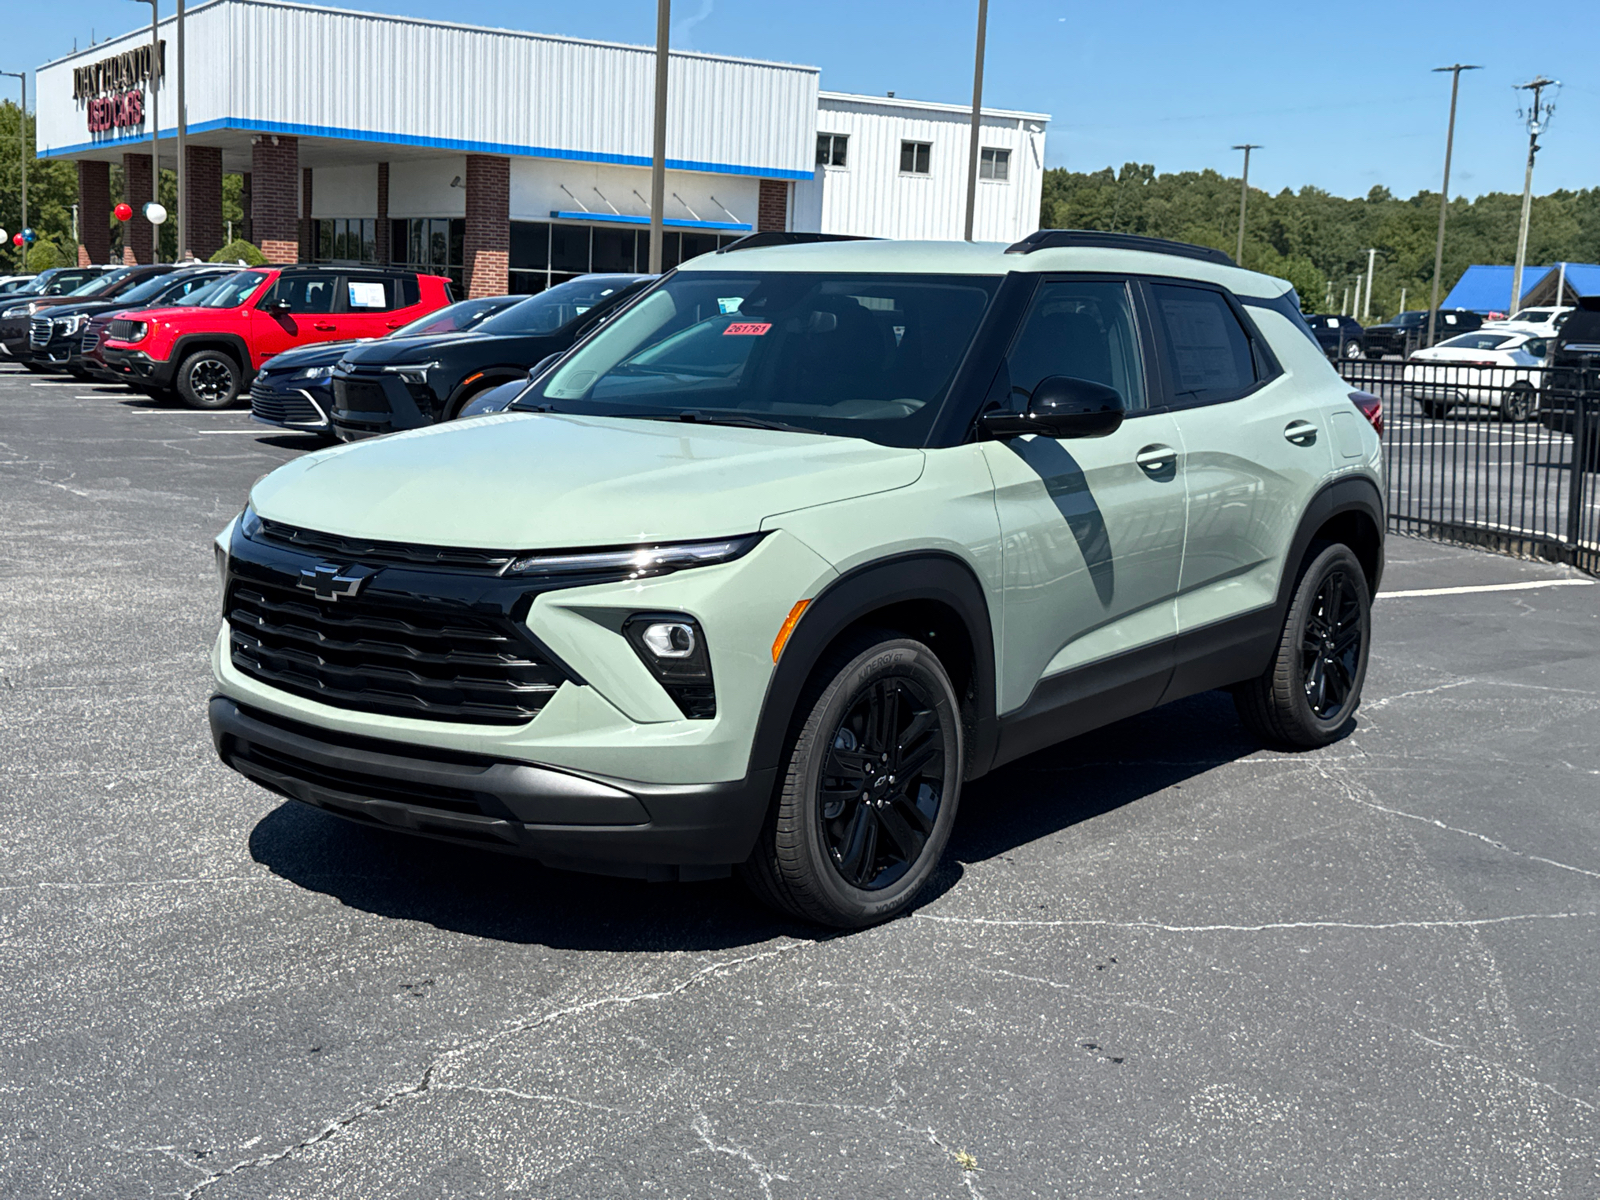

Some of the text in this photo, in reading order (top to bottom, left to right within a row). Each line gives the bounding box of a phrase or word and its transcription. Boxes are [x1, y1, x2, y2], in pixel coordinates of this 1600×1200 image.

[87, 89, 144, 132] USED CARS
[728, 324, 767, 333] 261761
